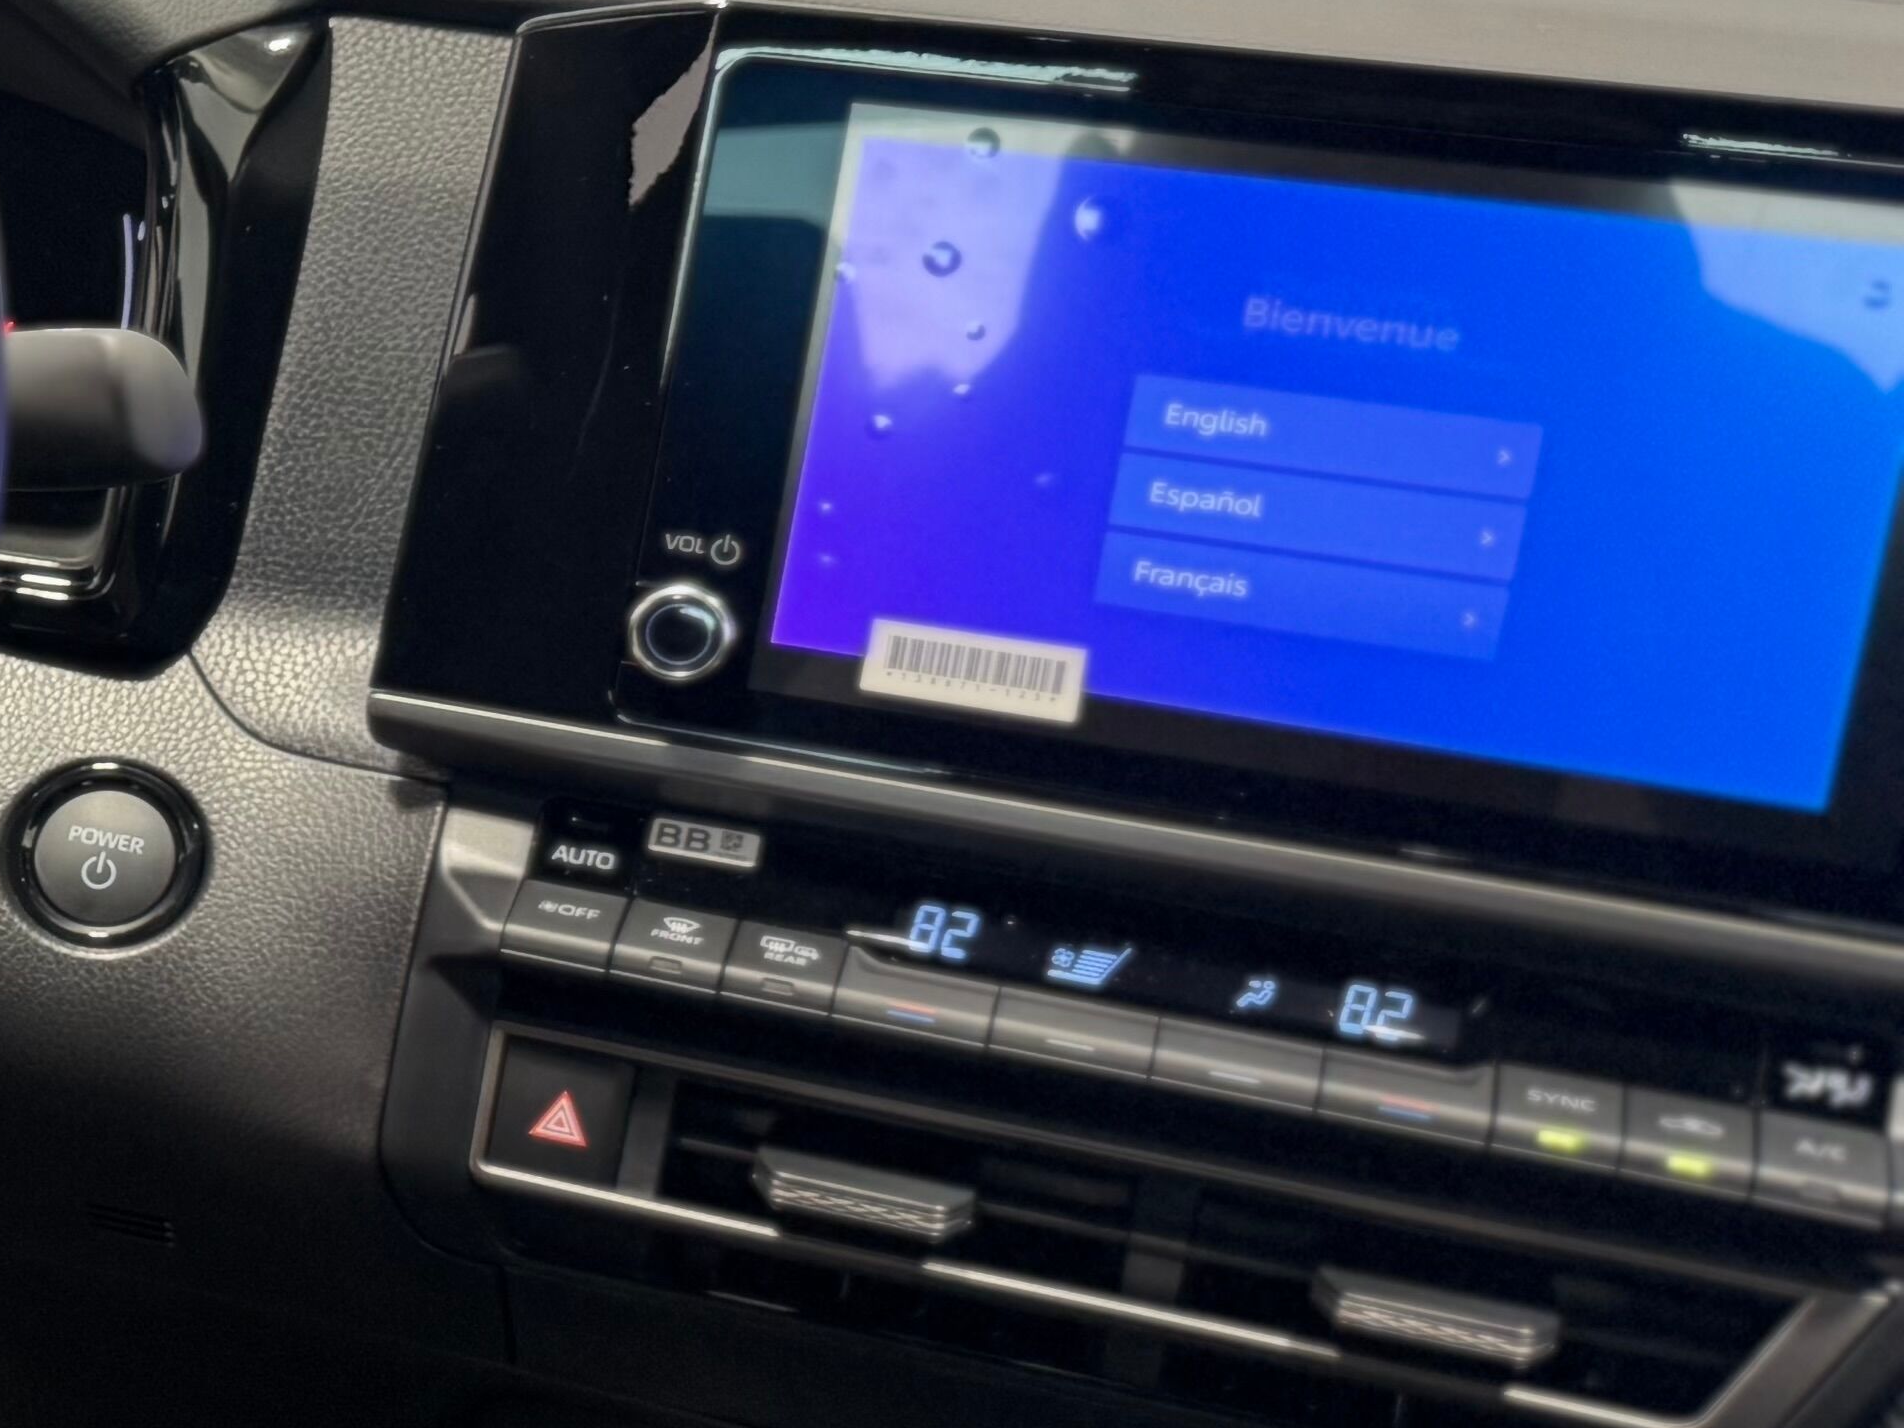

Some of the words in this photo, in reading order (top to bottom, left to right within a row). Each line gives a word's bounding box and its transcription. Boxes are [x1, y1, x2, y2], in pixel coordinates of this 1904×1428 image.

[1242, 295, 1460, 351] Bienvenue
[1163, 401, 1269, 436] English
[1149, 480, 1262, 518] Español
[665, 533, 705, 555] VOL
[1133, 560, 1249, 598] Français
[68, 824, 145, 855] POWER
[655, 821, 712, 853] BB
[551, 844, 616, 871] AUTO
[557, 903, 602, 920] OFF
[650, 928, 705, 946] FRONT
[908, 903, 981, 961] 82
[762, 951, 808, 967] REAR
[1339, 983, 1414, 1042] 82
[1526, 1088, 1597, 1113] SYNC
